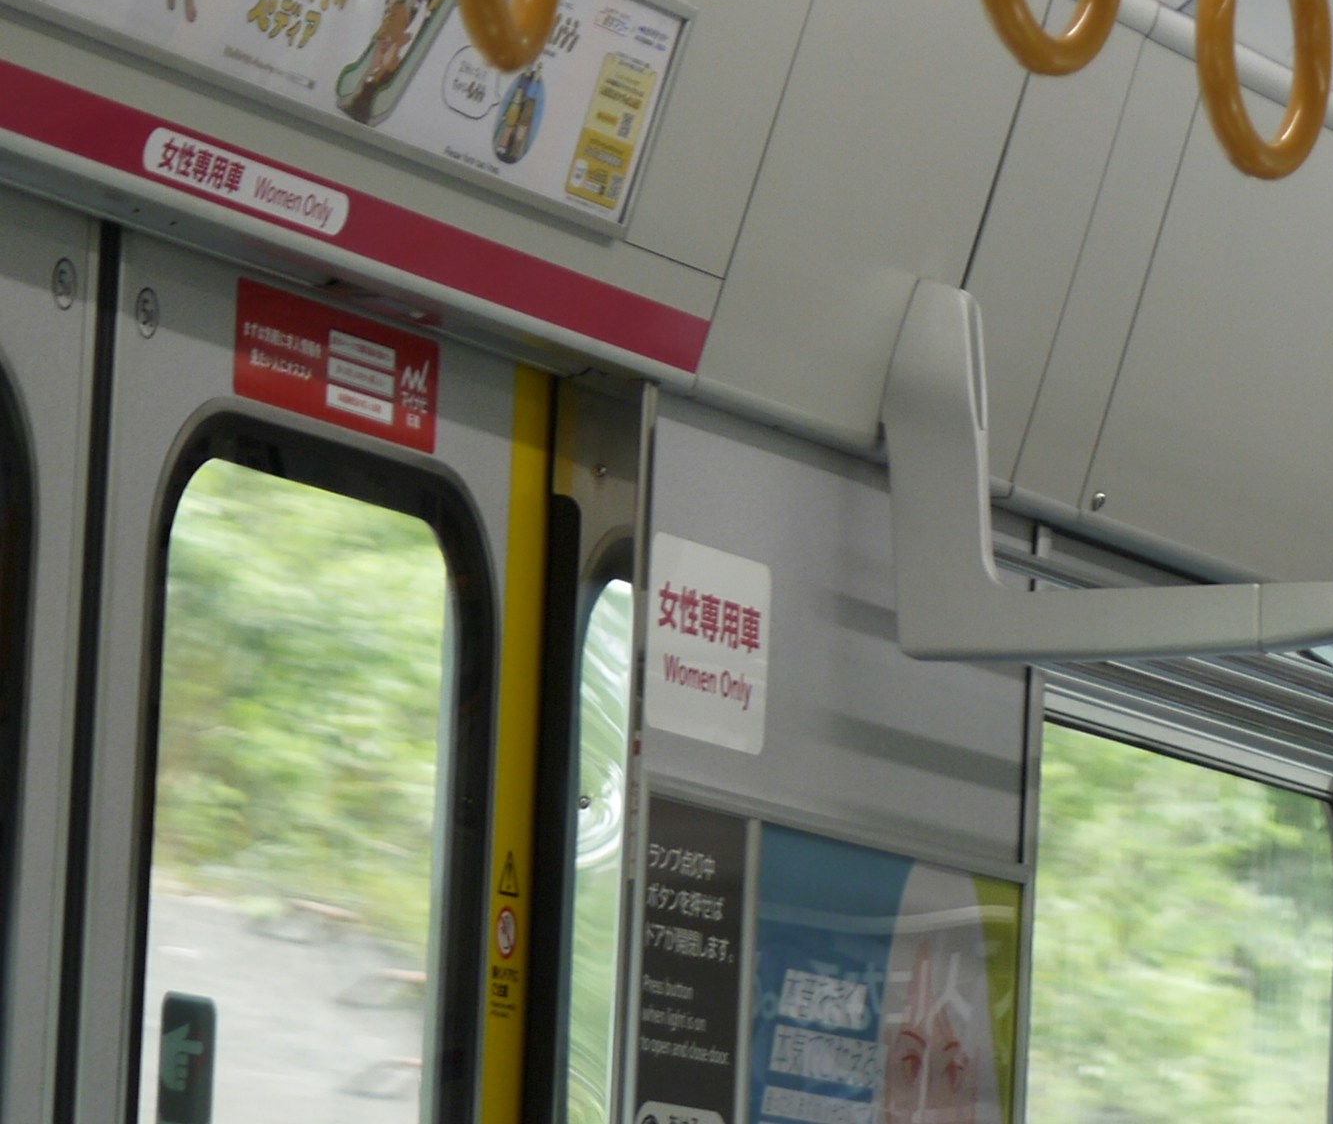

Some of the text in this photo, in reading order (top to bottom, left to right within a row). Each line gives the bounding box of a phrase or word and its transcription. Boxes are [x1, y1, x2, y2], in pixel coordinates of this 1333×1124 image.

[158, 137, 334, 228] 女性専用車 Women Only
[658, 580, 761, 654] 女性専用車
[663, 654, 753, 711] Women Only
[646, 882, 725, 922] ボタンを押せば
